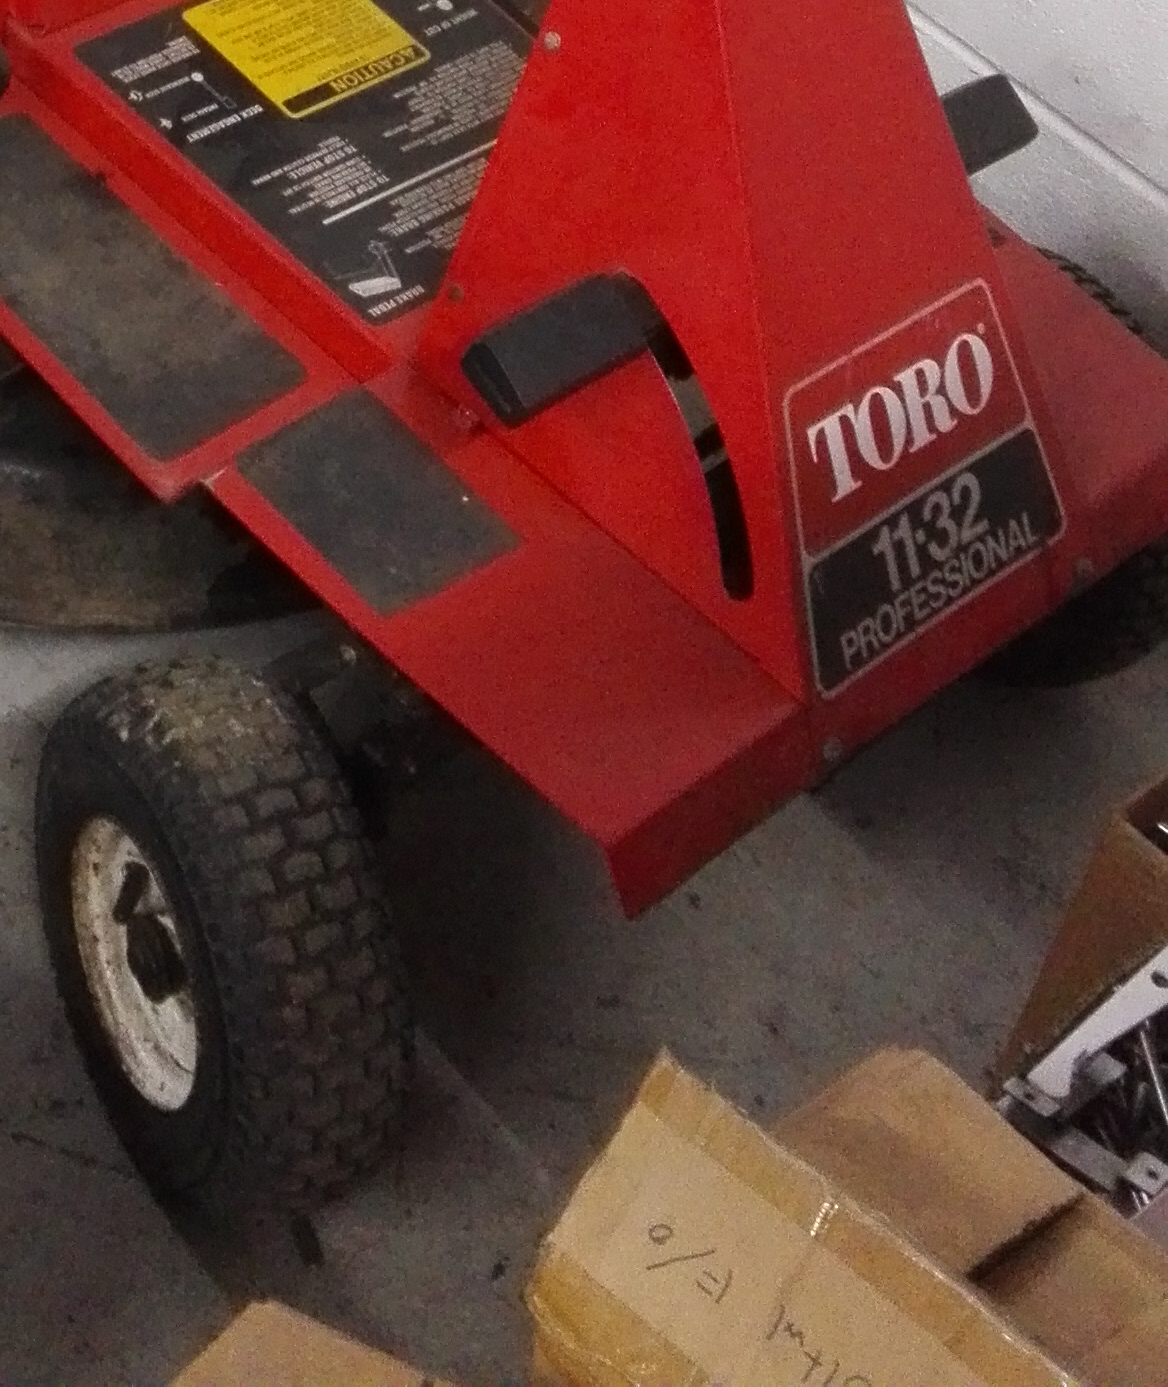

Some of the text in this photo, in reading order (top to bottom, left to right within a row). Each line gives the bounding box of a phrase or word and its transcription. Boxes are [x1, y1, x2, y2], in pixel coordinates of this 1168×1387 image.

[239, 104, 264, 119] DECK
[329, 53, 405, 93] CAUTION
[807, 333, 994, 503] TORO
[840, 511, 1038, 671] PROFESSIONAL
